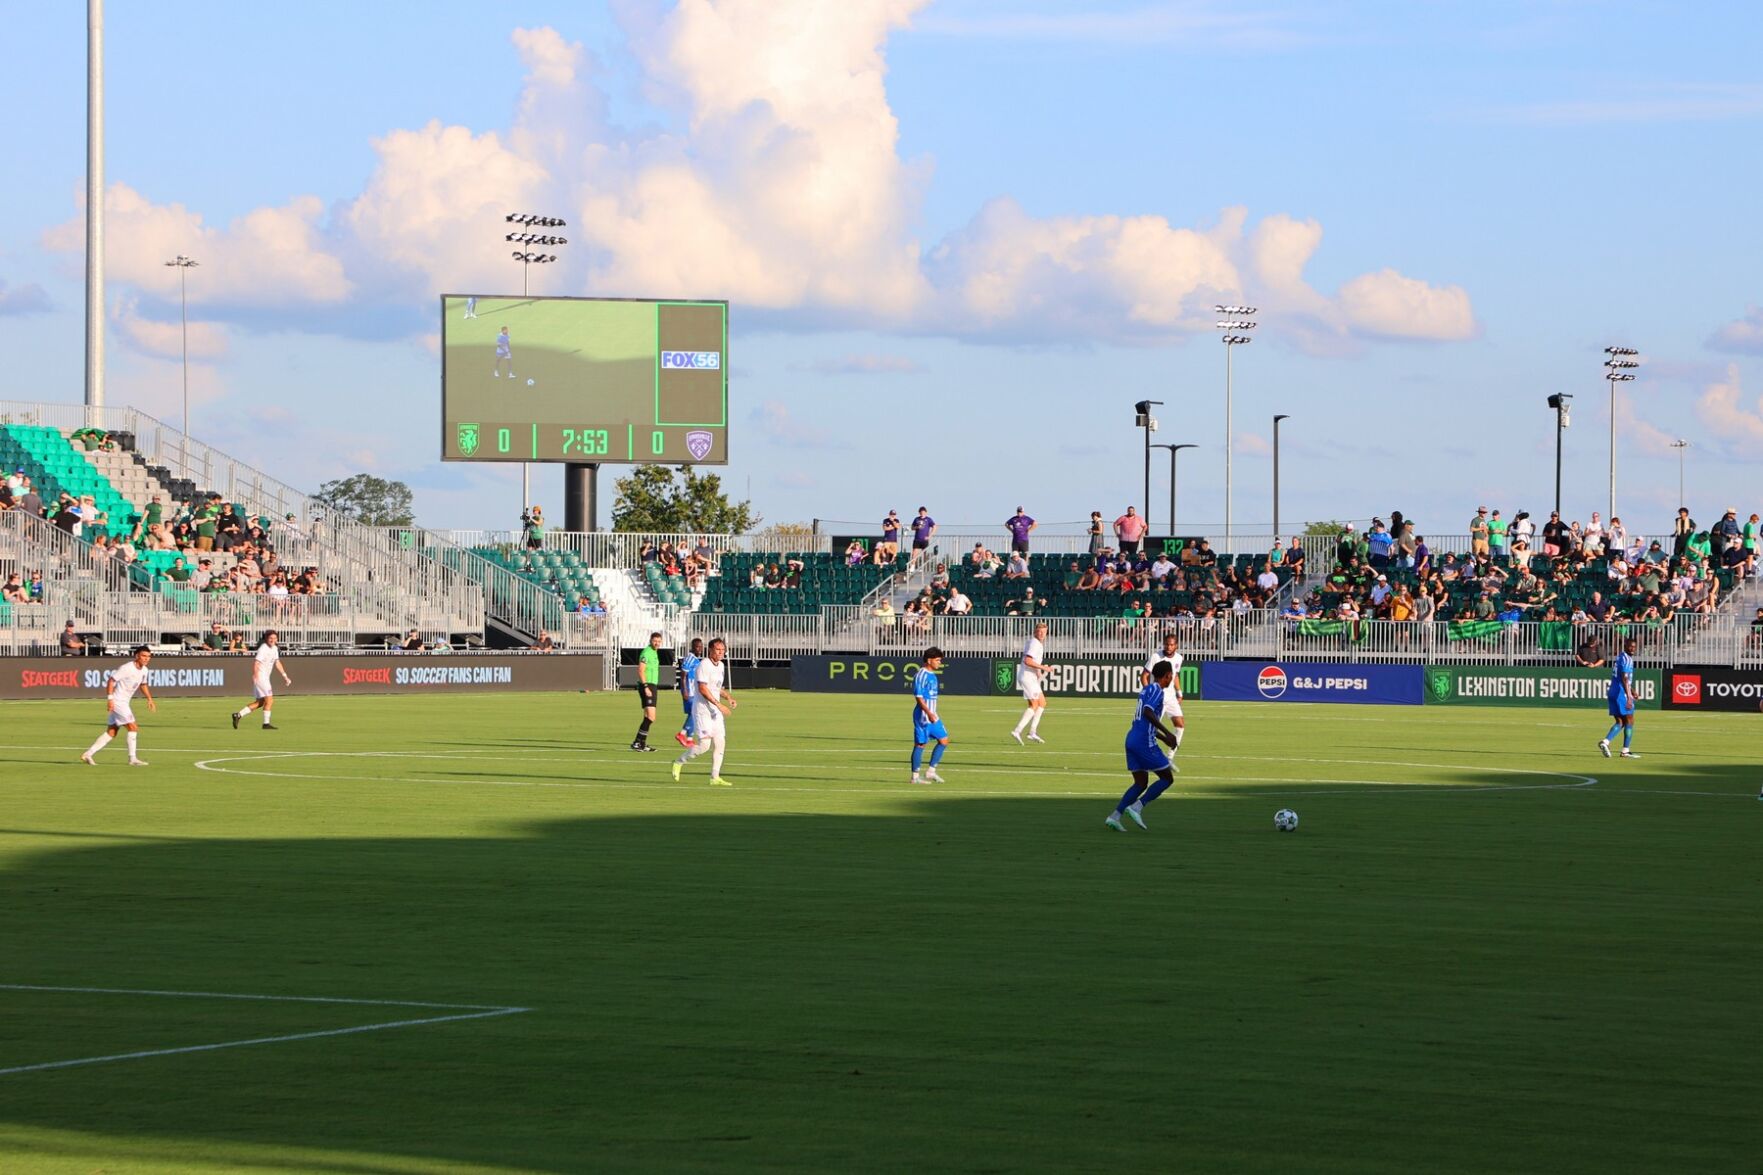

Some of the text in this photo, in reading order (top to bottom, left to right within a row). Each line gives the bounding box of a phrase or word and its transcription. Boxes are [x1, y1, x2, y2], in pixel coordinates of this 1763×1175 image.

[499, 429, 510, 452] 0
[562, 429, 608, 454] 7:53
[652, 431, 664, 454] 0
[21, 670, 79, 688] SEATGEEK
[84, 669, 101, 688] SO
[148, 669, 177, 687] FANS
[178, 669, 201, 686] CAN
[202, 669, 224, 686] FAN
[343, 667, 391, 684] SEATGEEK
[395, 667, 512, 684] SO SOCCER FANS CAN FAN
[1260, 678, 1286, 687] PEPSI
[1293, 677, 1368, 690] G&J PEPSI
[1458, 676, 1535, 697] LEXINGTON
[1540, 678, 1612, 699] SPORTING
[1706, 683, 1763, 697] TOYOT
